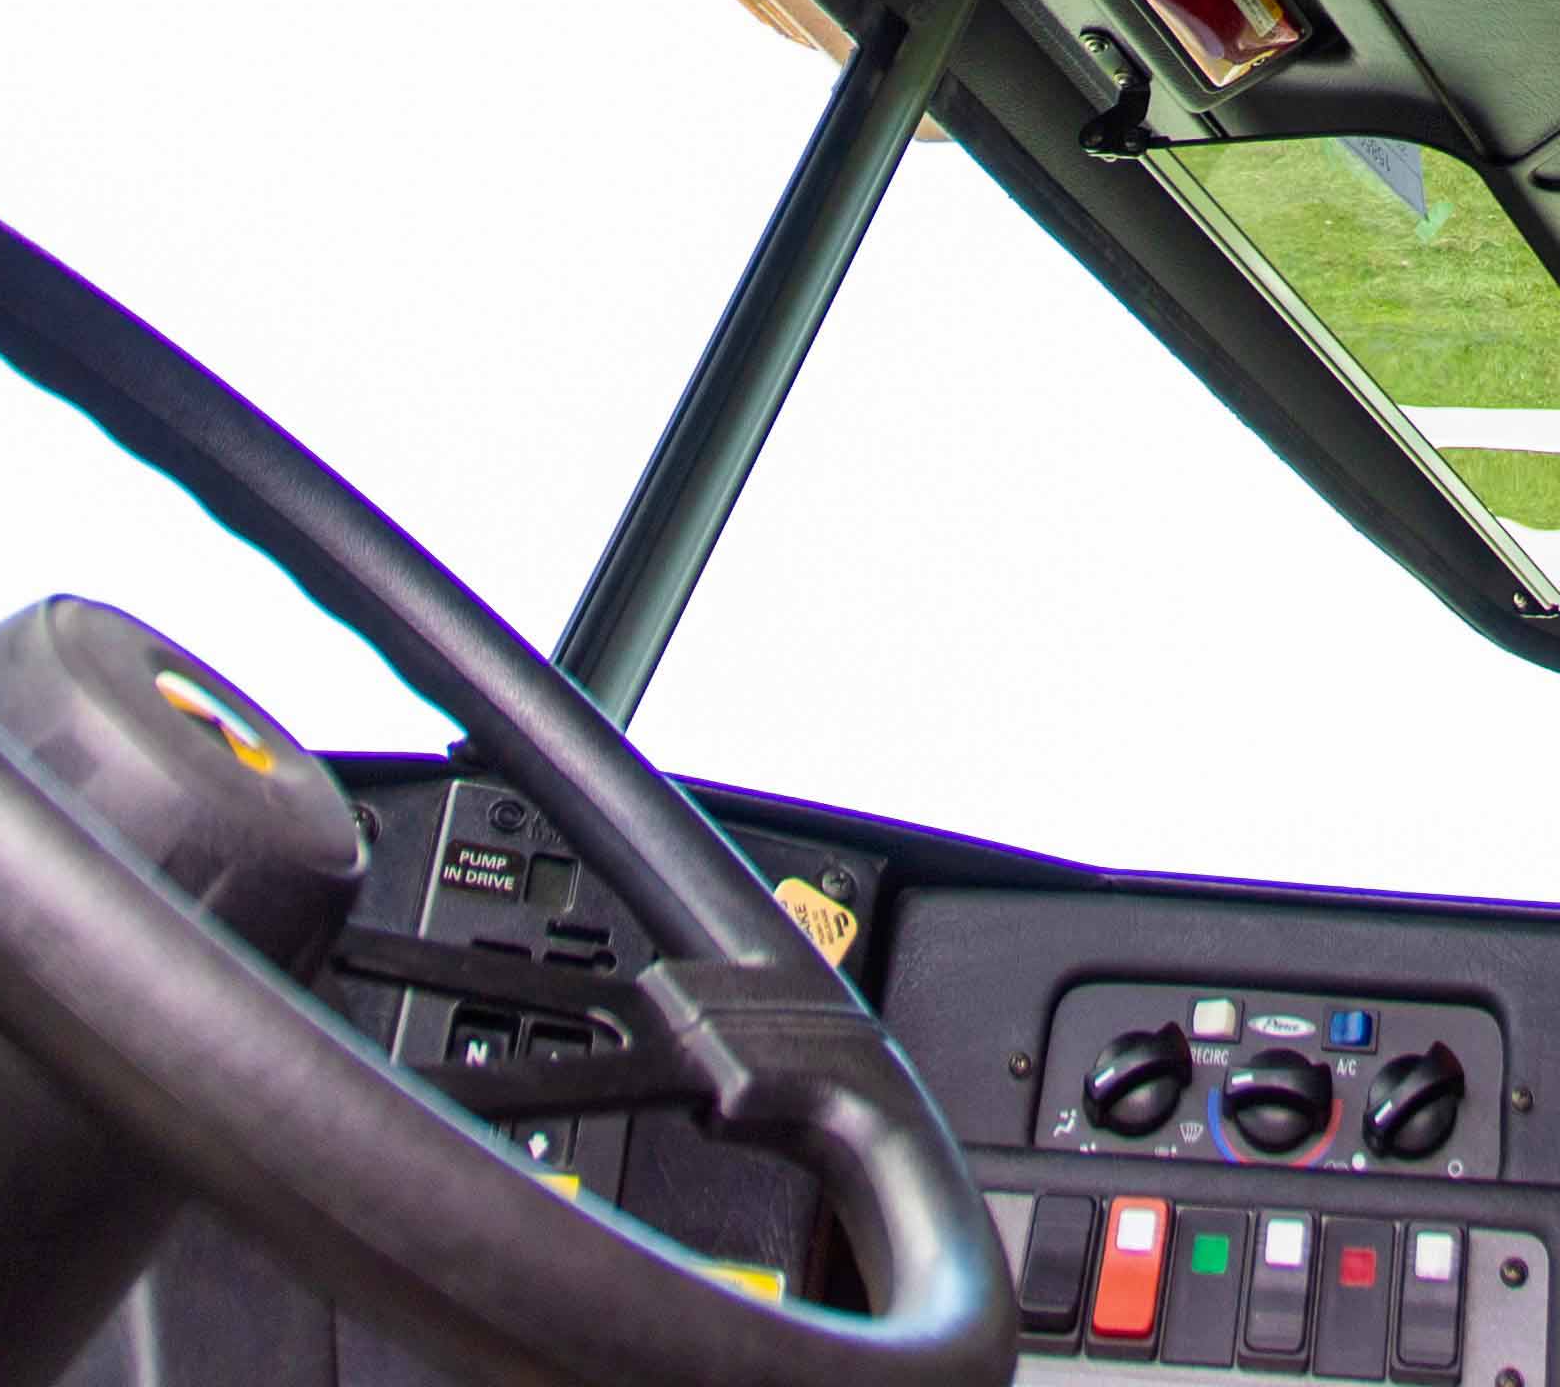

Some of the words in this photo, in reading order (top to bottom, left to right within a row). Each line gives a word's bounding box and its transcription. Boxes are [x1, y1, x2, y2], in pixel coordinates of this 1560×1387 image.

[459, 850, 508, 871] PUMP
[443, 865, 462, 882] IN
[465, 869, 515, 891] DRIVE
[465, 1040, 488, 1066] N
[1190, 1045, 1230, 1066] RECIRC
[1336, 1058, 1357, 1076] A/C
